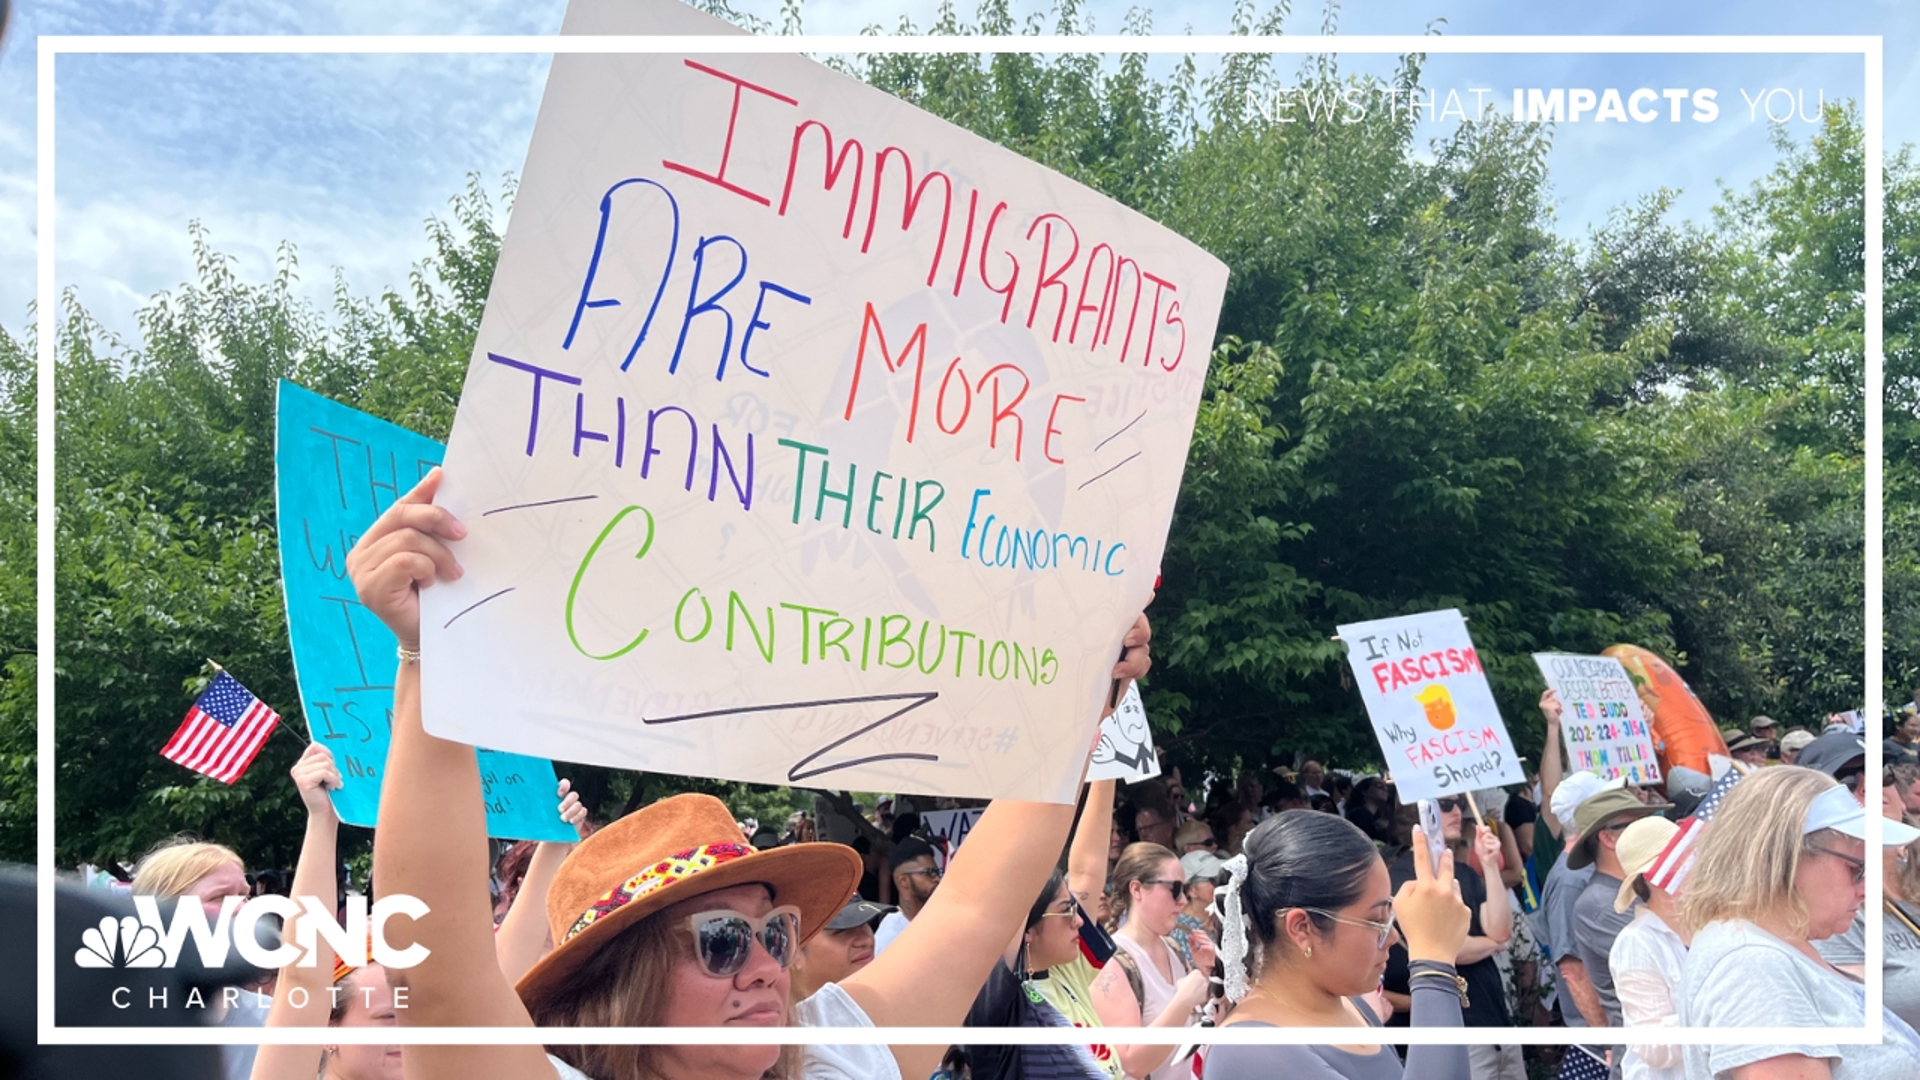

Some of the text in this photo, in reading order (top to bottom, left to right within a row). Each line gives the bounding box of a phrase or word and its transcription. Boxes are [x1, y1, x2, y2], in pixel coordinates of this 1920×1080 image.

[663, 59, 1187, 371] IMMIGRANTS
[563, 178, 1086, 465] ARE MORE
[488, 353, 1127, 577] THAN THEIR ECONOMIC
[565, 505, 1059, 685] CONTRIBUTIONS
[1359, 629, 1424, 661] If Not
[1371, 646, 1482, 696] FASCISM
[312, 701, 373, 743] IS
[1599, 701, 1629, 718] BUDD
[1383, 723, 1417, 745] Why
[1405, 726, 1501, 768] FASCISM
[504, 773, 526, 786] on
[1433, 750, 1506, 788] Shaped?
[1577, 749, 1609, 769] THOM
